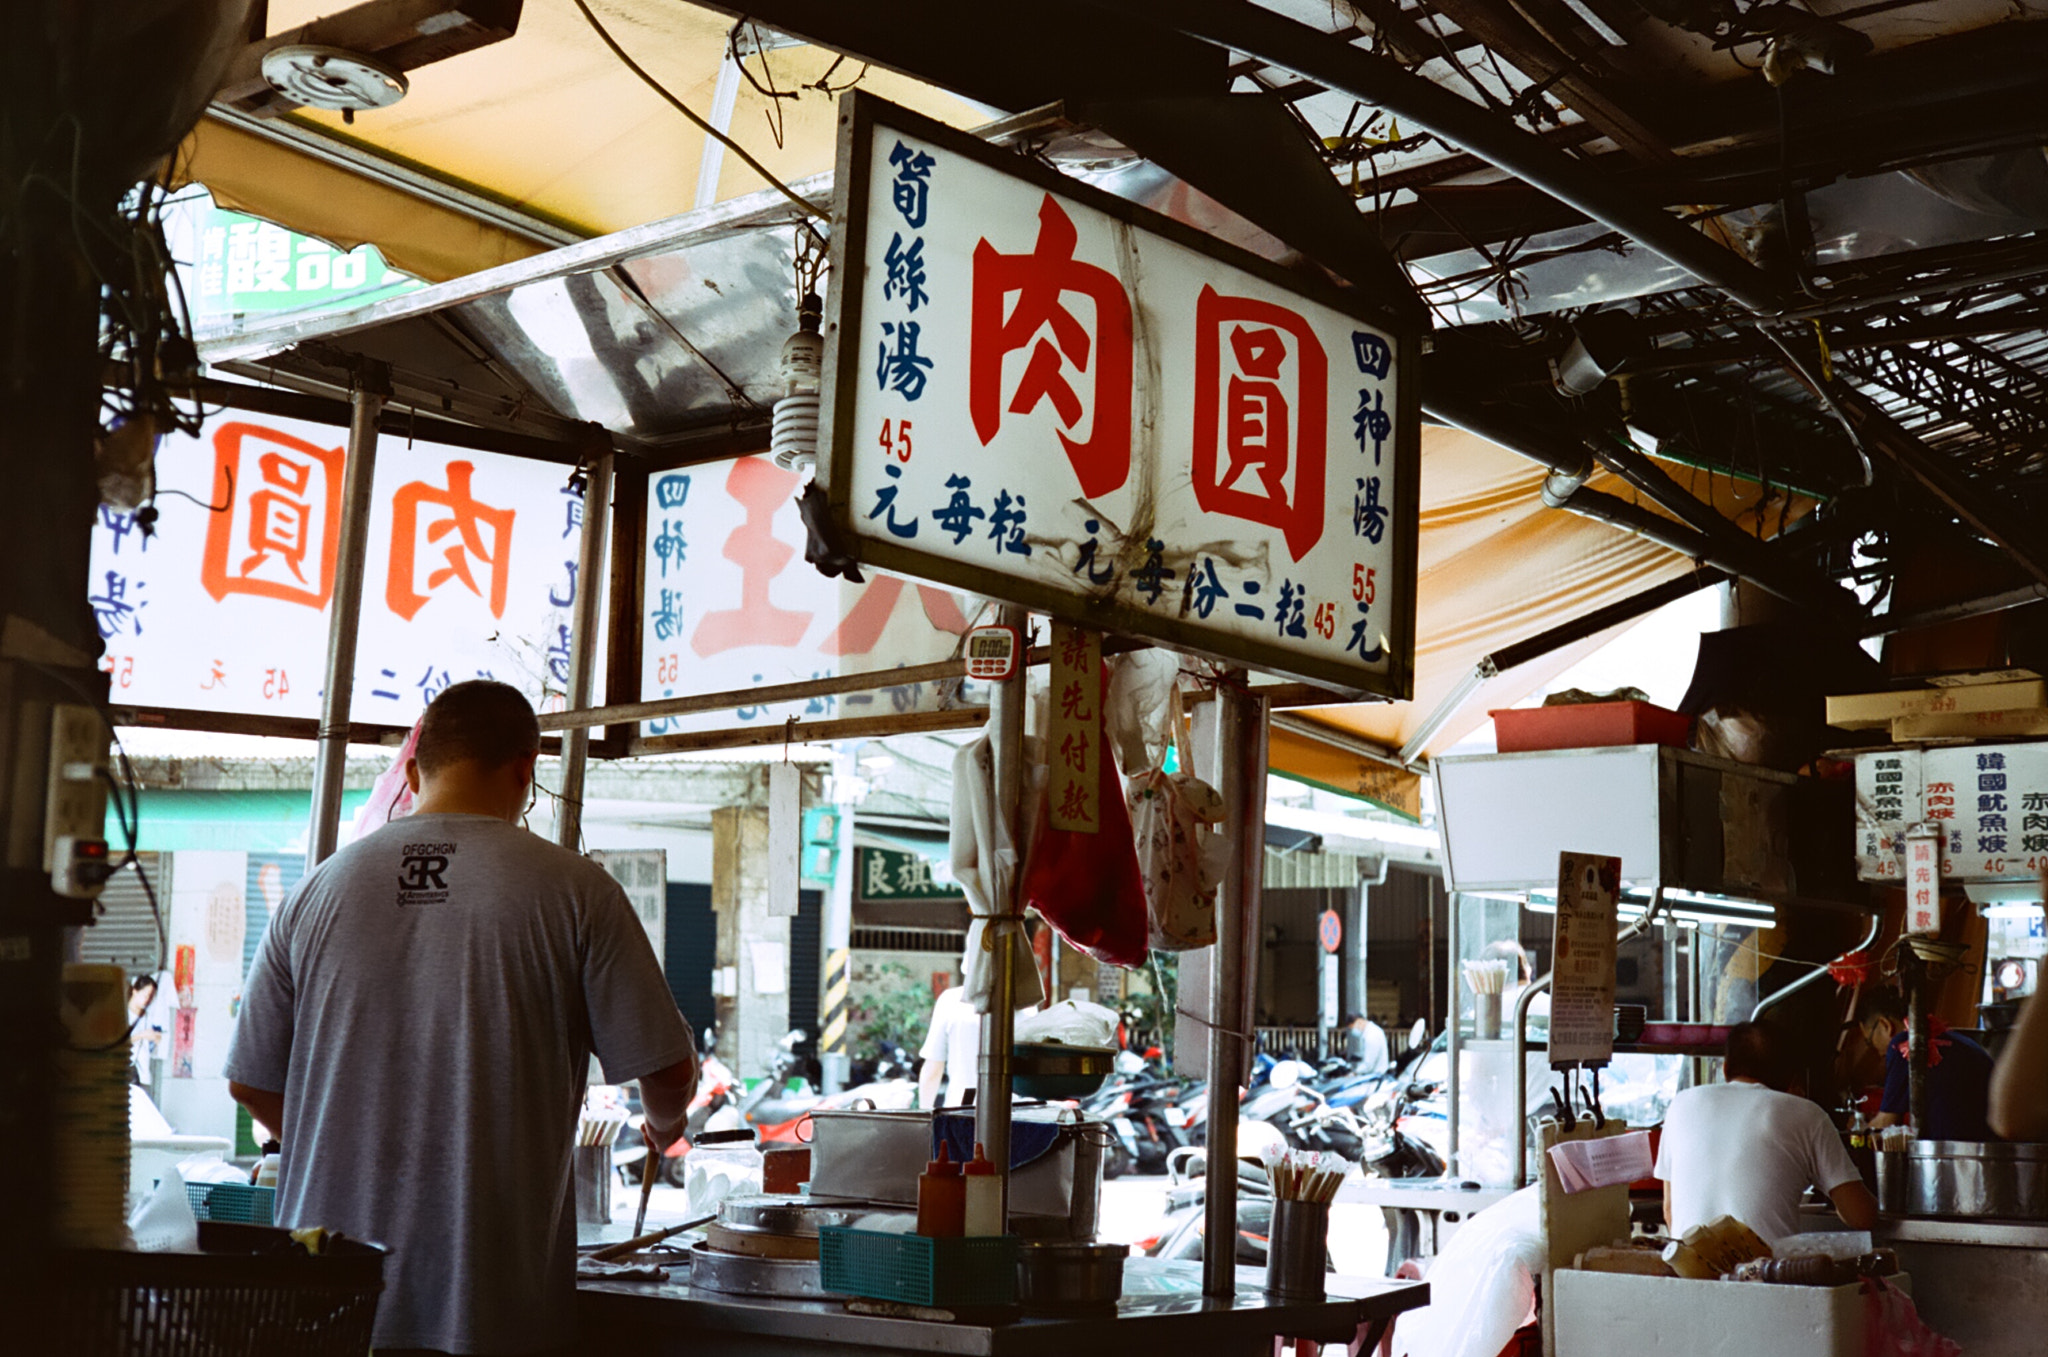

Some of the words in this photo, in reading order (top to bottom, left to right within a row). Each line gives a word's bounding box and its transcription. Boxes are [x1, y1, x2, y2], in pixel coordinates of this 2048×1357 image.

[875, 140, 936, 401] 筍絲湯
[969, 192, 1329, 564] 肉圓
[878, 417, 913, 464] 45
[1351, 330, 1392, 546] 四神湯
[1313, 602, 1336, 641] 45
[1351, 562, 1377, 605] 55
[1056, 632, 1094, 823] 請先付款
[1975, 752, 2009, 854] 韓國魷魚焿
[1876, 860, 1896, 876] 45
[1914, 845, 1932, 928] 請先付款
